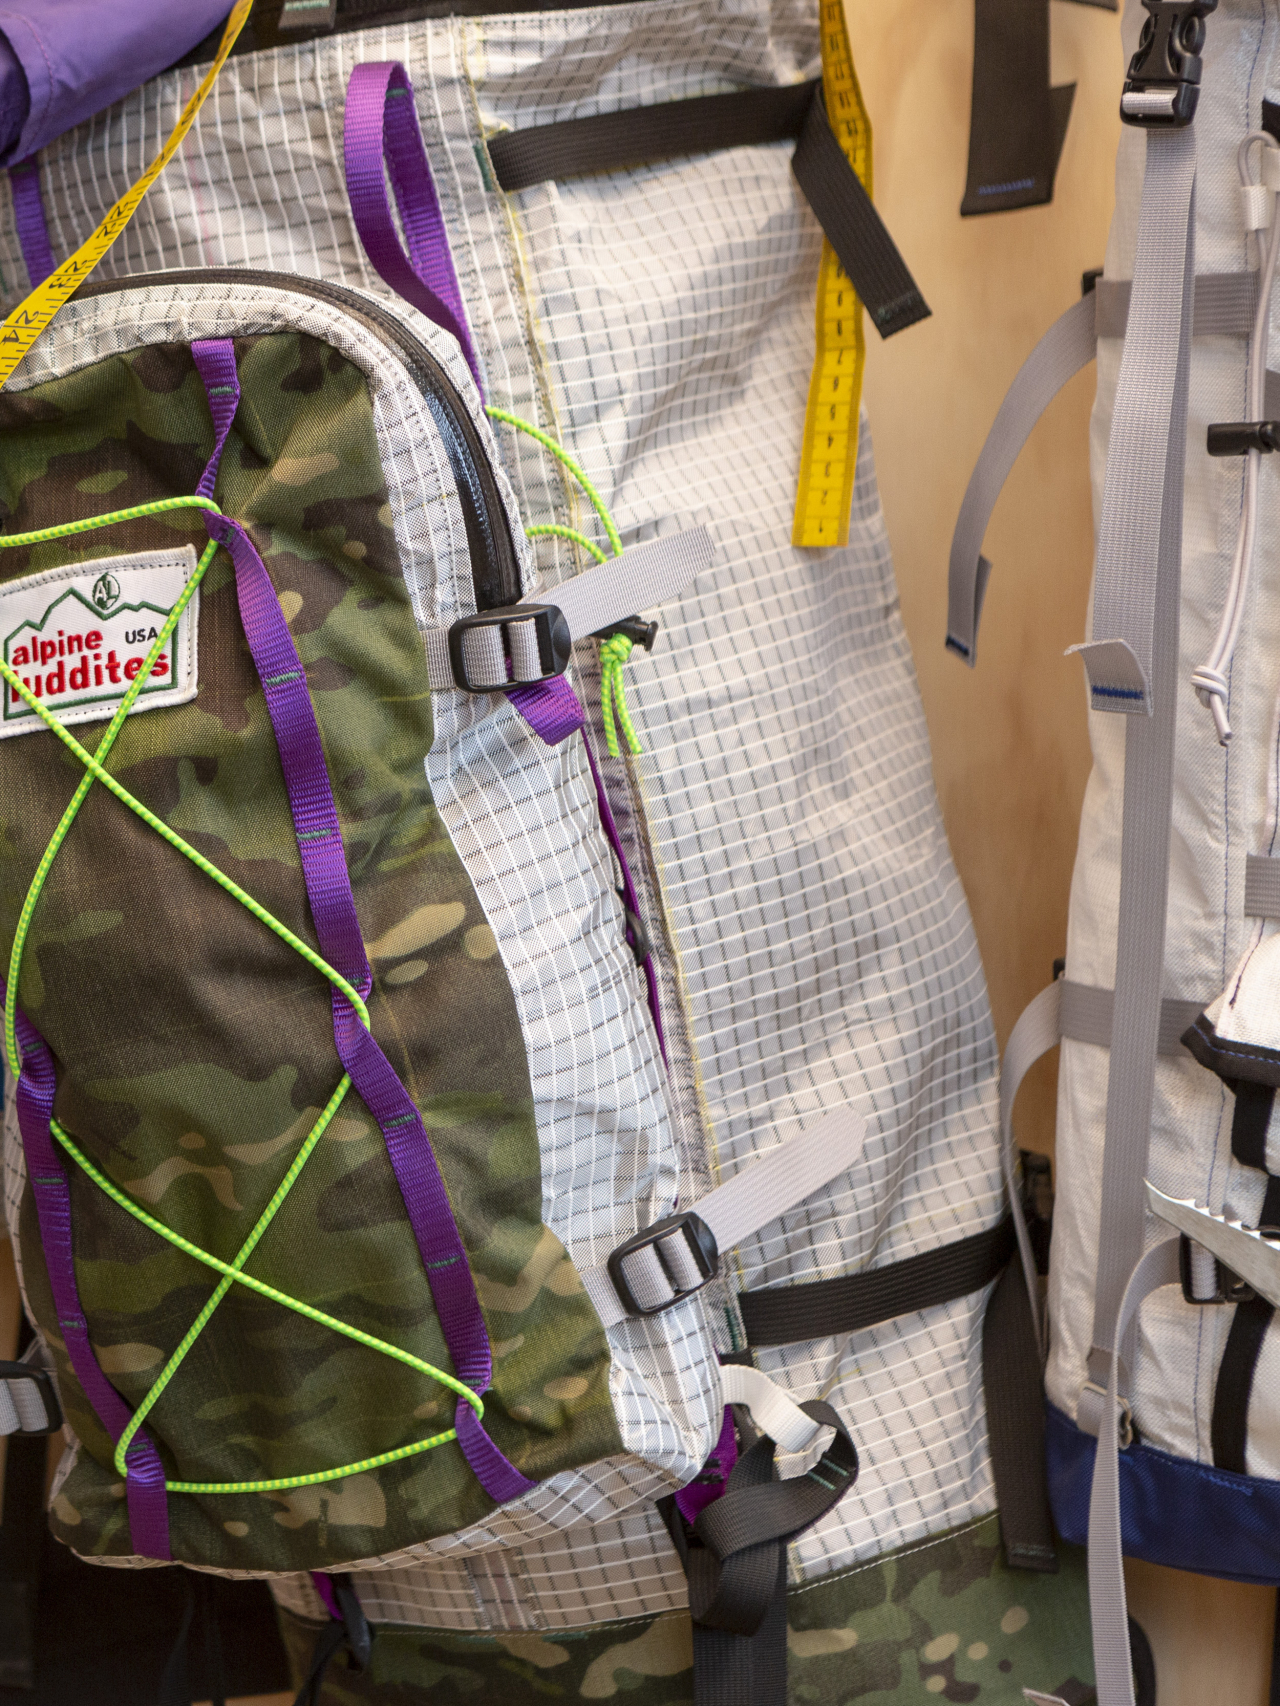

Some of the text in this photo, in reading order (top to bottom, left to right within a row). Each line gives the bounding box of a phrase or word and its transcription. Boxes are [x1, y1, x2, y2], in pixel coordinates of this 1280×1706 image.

[0, 309, 40, 346] 24
[836, 349, 844, 366] 7
[829, 405, 836, 421] 5
[826, 433, 835, 450] 4
[823, 461, 832, 478] 3
[819, 489, 828, 506] 2
[125, 626, 159, 645] USA
[11, 629, 104, 667] alpine
